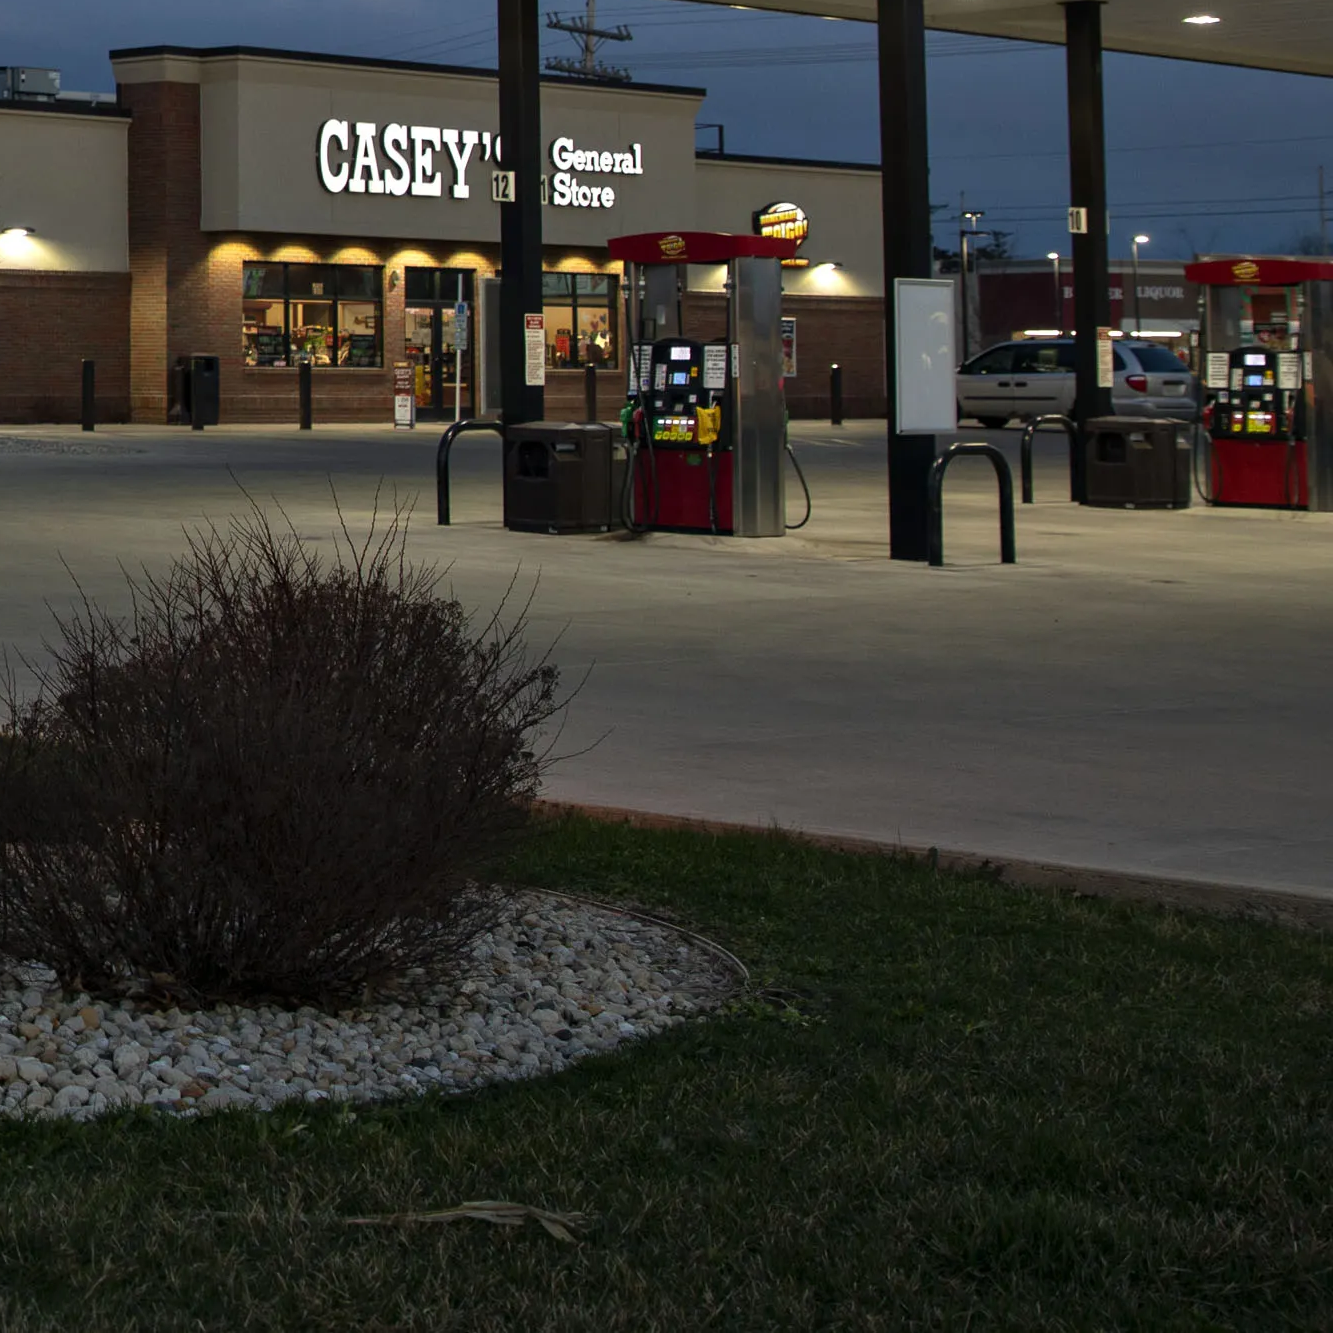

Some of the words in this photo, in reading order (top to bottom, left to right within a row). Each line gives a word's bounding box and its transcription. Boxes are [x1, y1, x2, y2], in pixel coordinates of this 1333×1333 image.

[319, 118, 501, 201] CASEY'
[552, 136, 644, 175] General
[494, 174, 509, 198] 12
[553, 172, 615, 208] Store
[1069, 210, 1082, 231] 10
[1136, 286, 1183, 300] LIQUOR
